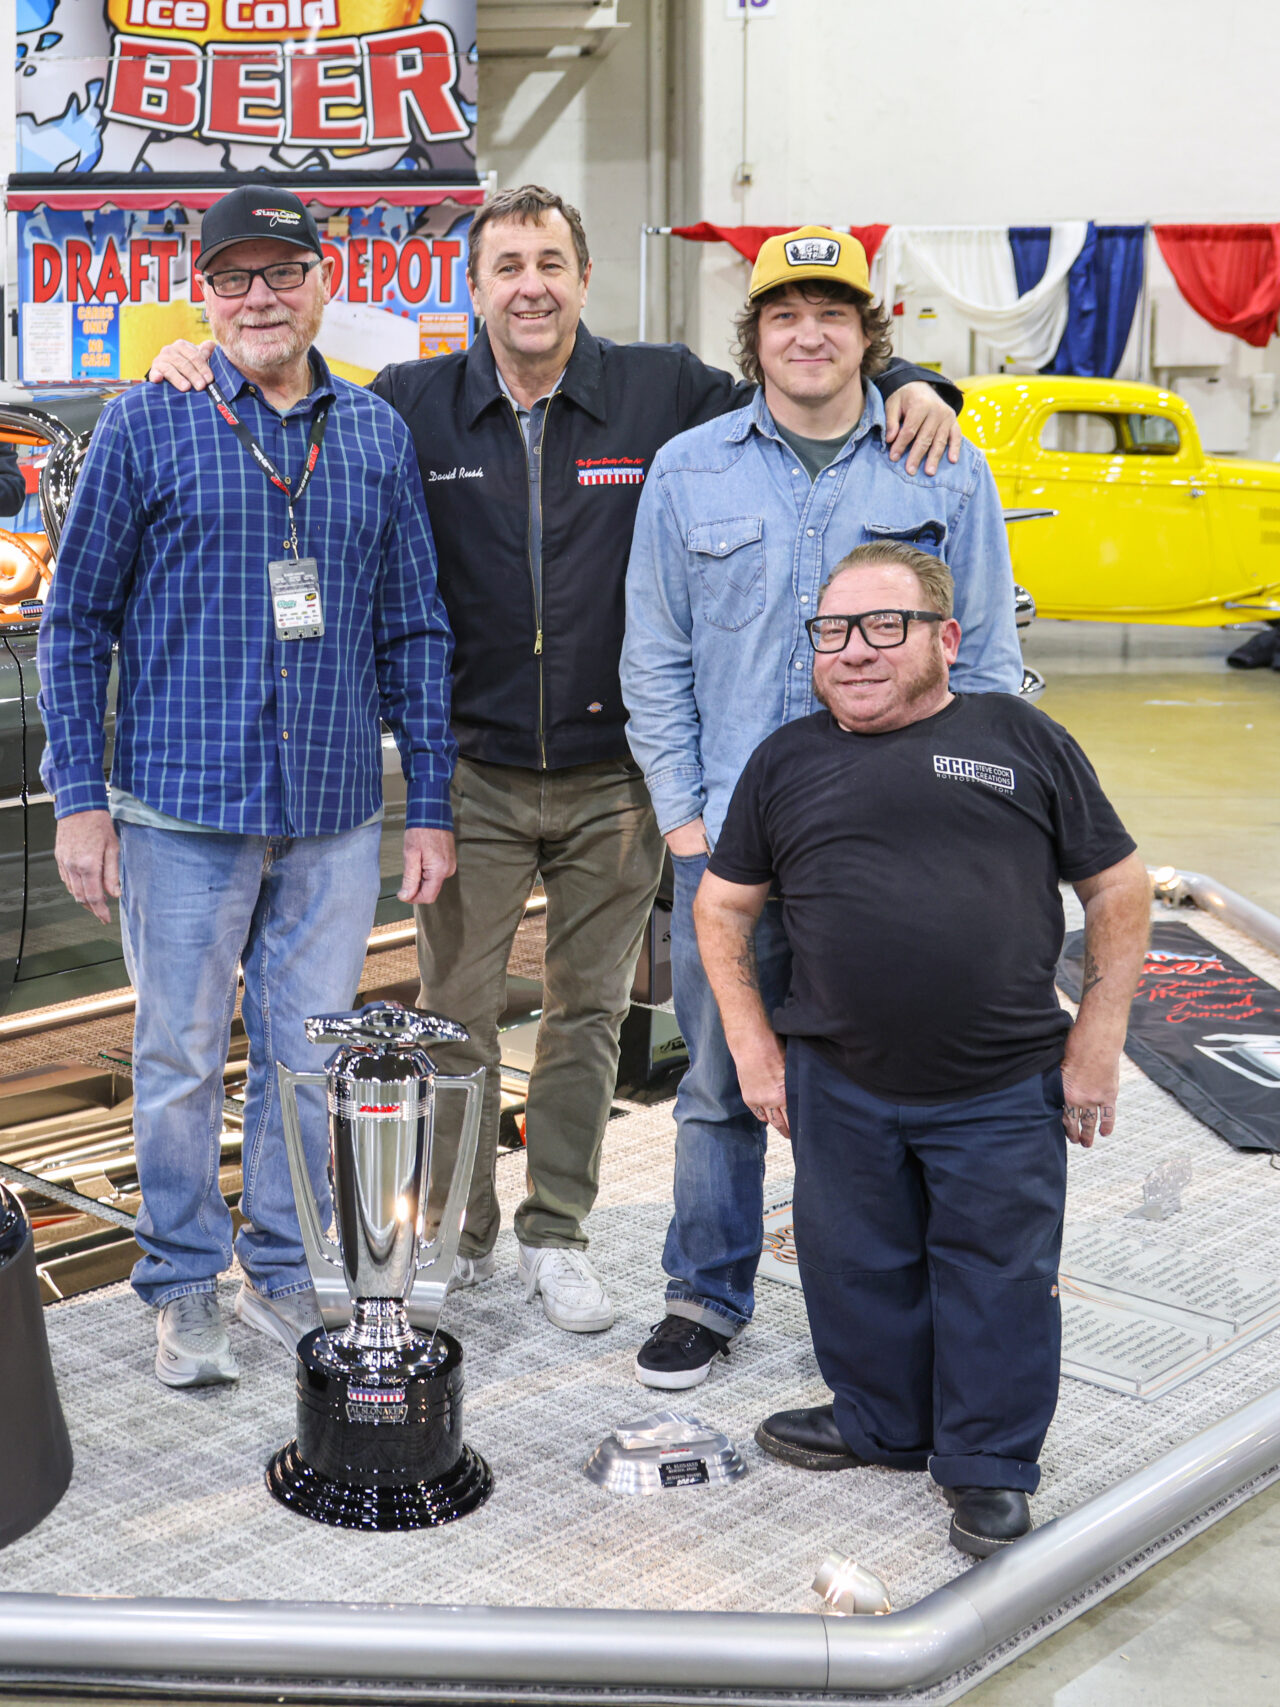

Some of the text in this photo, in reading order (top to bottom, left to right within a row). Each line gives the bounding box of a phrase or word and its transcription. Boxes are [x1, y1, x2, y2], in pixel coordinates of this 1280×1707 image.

[127, 0, 339, 30] Ice Cold
[104, 23, 472, 146] BEER
[33, 236, 179, 304] DRAFT
[77, 305, 115, 320] CARDS
[82, 320, 110, 334] ONLY
[88, 339, 104, 353] NO
[81, 353, 111, 367] CASH
[428, 467, 457, 481] David
[935, 757, 973, 776] SCC
[975, 764, 1010, 778] STEVE COOK
[975, 771, 1011, 786] CREATIONS
